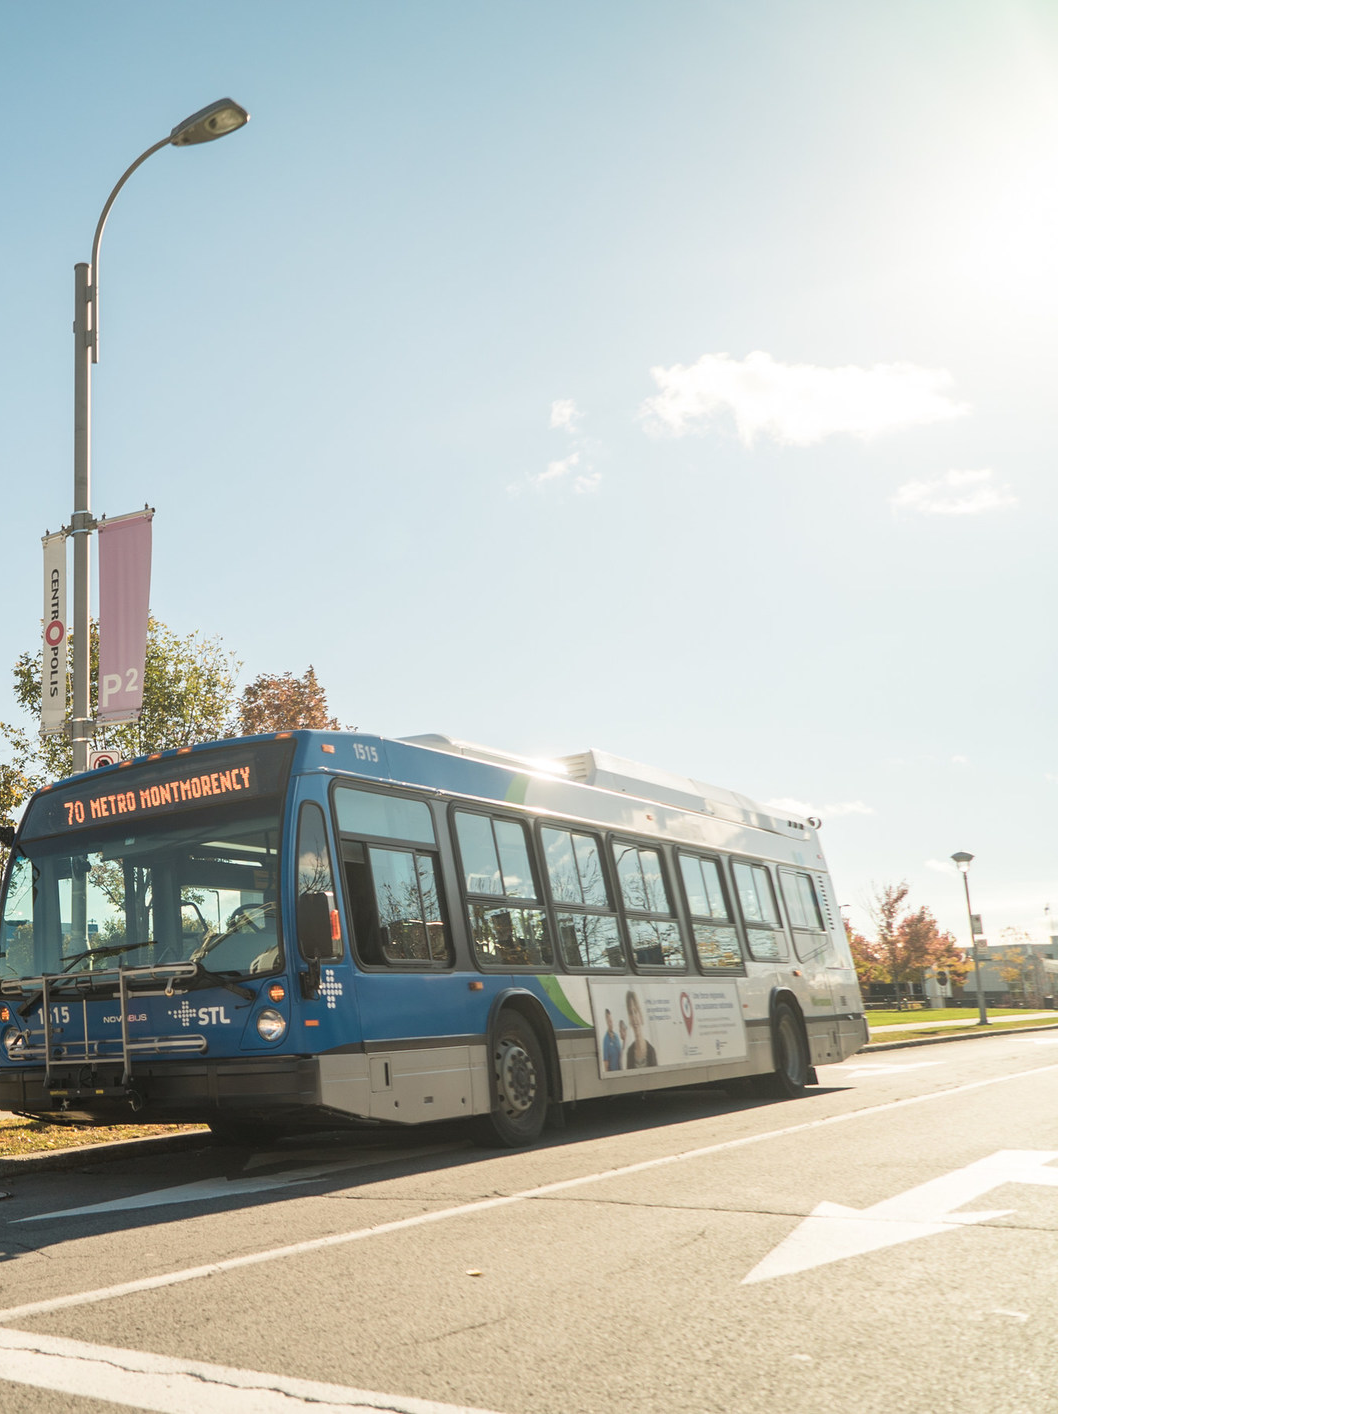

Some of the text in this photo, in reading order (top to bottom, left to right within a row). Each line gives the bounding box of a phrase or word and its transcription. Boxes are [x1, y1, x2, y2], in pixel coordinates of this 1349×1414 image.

[45, 568, 64, 698] CENTROPOLIS
[102, 667, 139, 708] P2
[353, 743, 379, 763] 1515
[63, 766, 251, 825] 70 METRO MONTMORENCY
[37, 1006, 70, 1025] 115
[103, 1013, 148, 1024] NOVBUS
[198, 1006, 231, 1026] STL
